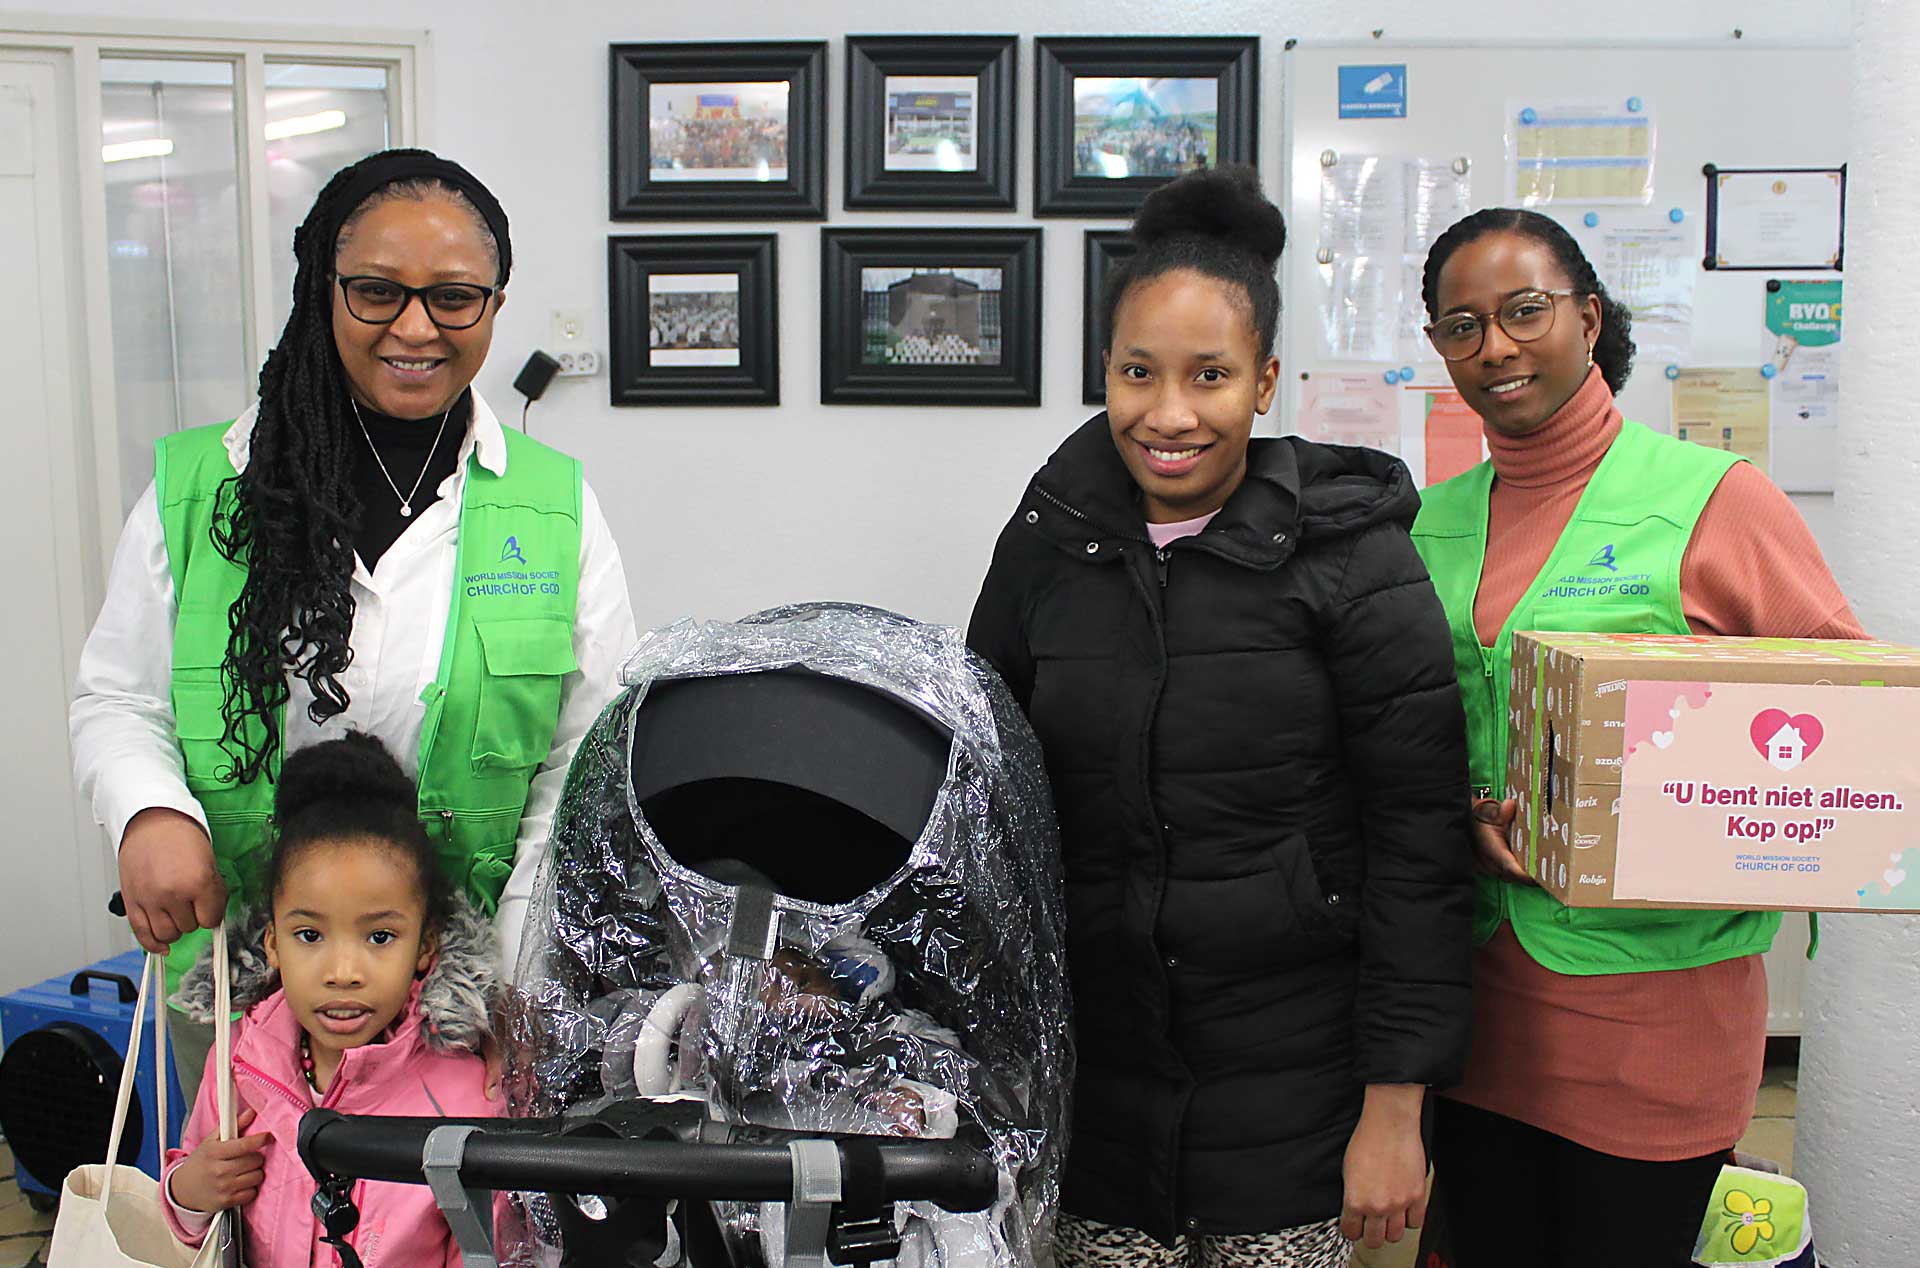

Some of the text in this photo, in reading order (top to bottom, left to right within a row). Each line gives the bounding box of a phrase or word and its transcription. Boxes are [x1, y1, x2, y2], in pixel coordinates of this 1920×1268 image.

[465, 572, 495, 583] WORLD
[467, 583, 560, 597] CHURCH OF GOD
[1598, 585, 1616, 595] OF
[1619, 584, 1650, 595] GOD
[1663, 783, 1903, 810] “U bent niet alleen.
[1727, 816, 1834, 843] Kop op!”
[1735, 862, 1820, 873] CHURCH OF GOD
